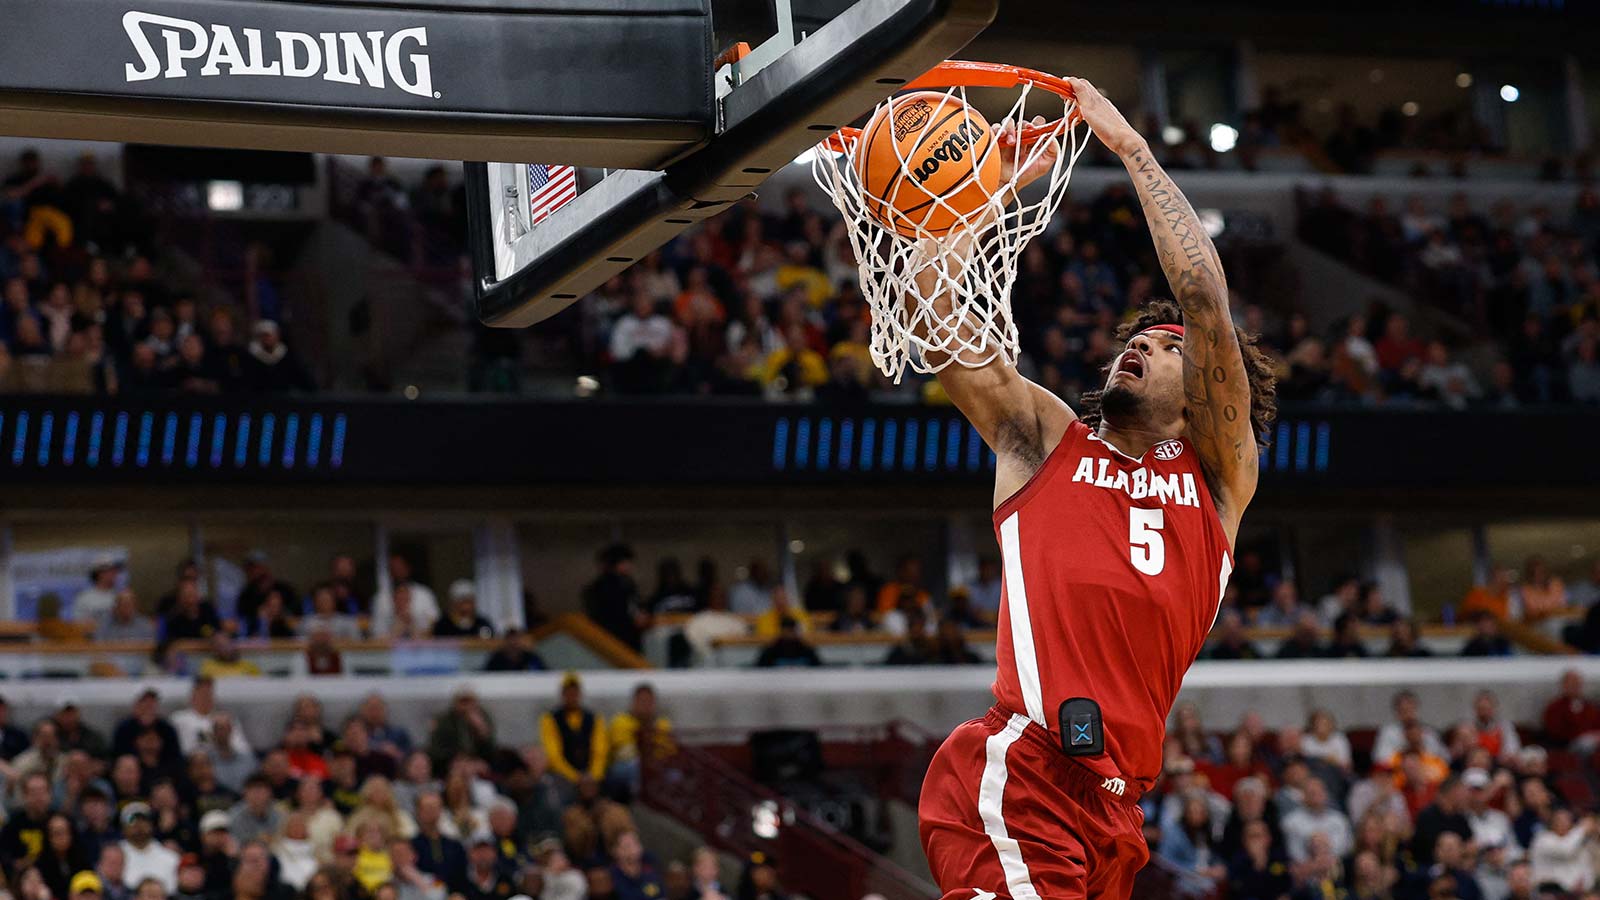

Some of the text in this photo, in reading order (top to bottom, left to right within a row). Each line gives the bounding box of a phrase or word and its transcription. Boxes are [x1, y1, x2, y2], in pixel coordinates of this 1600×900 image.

[122, 10, 433, 98] SPALDING
[903, 109, 925, 130] MARCH
[937, 130, 949, 142] EVO
[906, 118, 984, 188] Wilson
[1154, 440, 1182, 460] SEC
[1072, 457, 1200, 508] ALABAMA
[1130, 506, 1165, 576] 5
